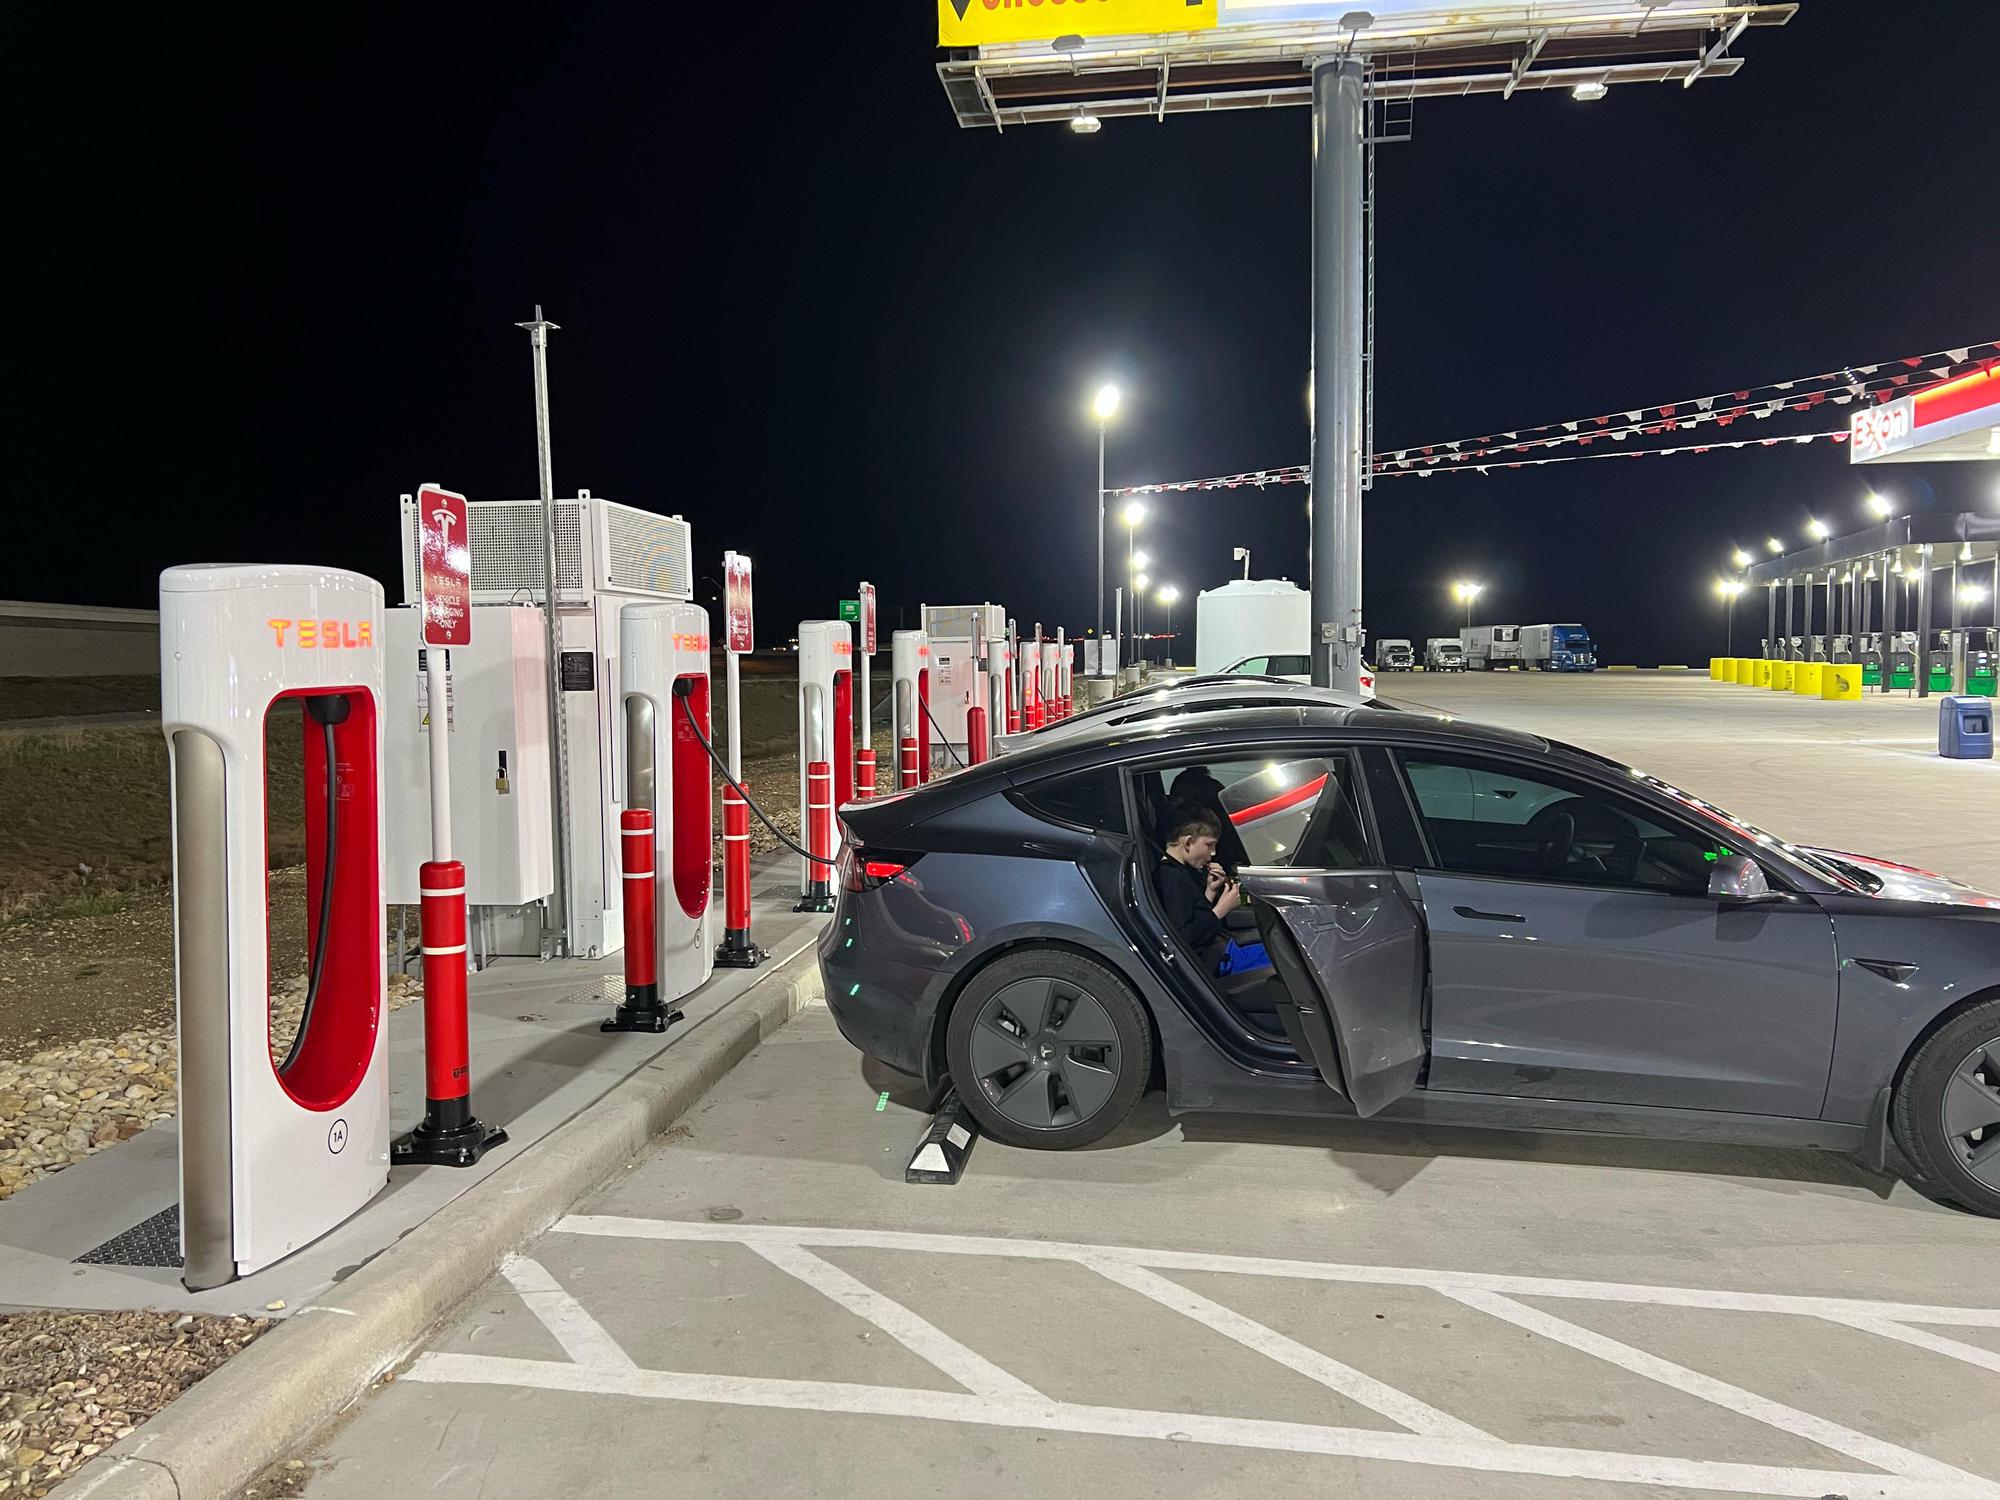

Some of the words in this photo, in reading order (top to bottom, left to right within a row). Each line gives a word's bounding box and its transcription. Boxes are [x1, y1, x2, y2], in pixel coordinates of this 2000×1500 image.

[433, 575, 461, 587] TESLA
[440, 618, 458, 629] ONLY
[267, 619, 372, 648] TESLA
[333, 1130, 343, 1142] 1A
